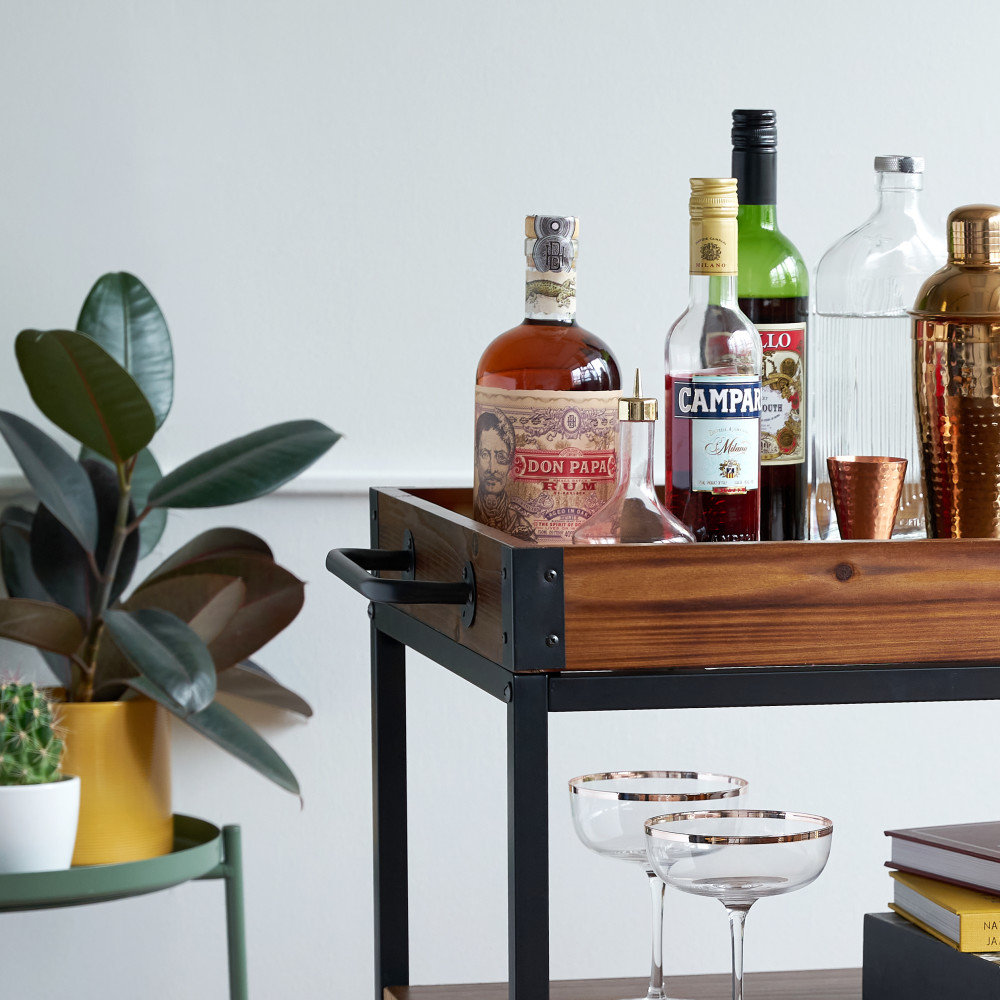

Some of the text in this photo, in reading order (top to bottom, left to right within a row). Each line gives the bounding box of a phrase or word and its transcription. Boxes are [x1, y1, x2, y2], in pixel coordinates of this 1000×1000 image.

[528, 460, 607, 474] DON PAPA
[542, 482, 597, 491] RUM
